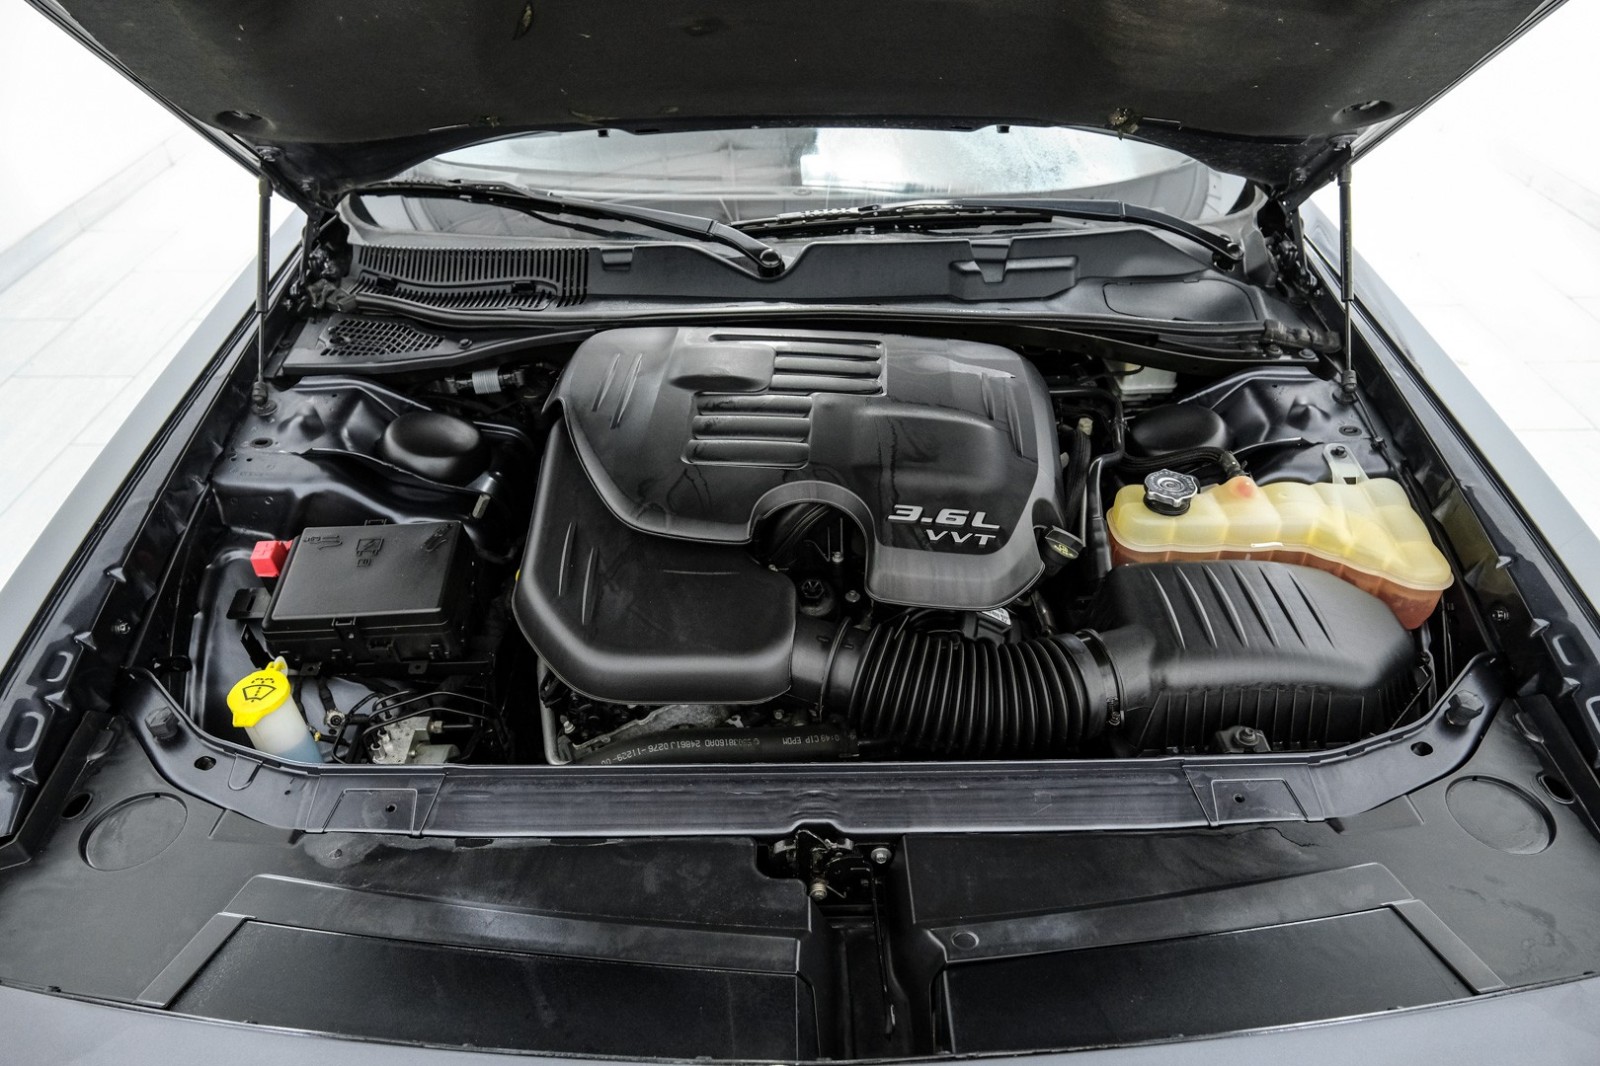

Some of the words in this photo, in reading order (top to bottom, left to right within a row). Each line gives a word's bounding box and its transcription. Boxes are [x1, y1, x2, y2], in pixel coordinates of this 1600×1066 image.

[888, 504, 1000, 529] 3.6L
[926, 529, 996, 545] VVT
[783, 737, 802, 745] EPDM
